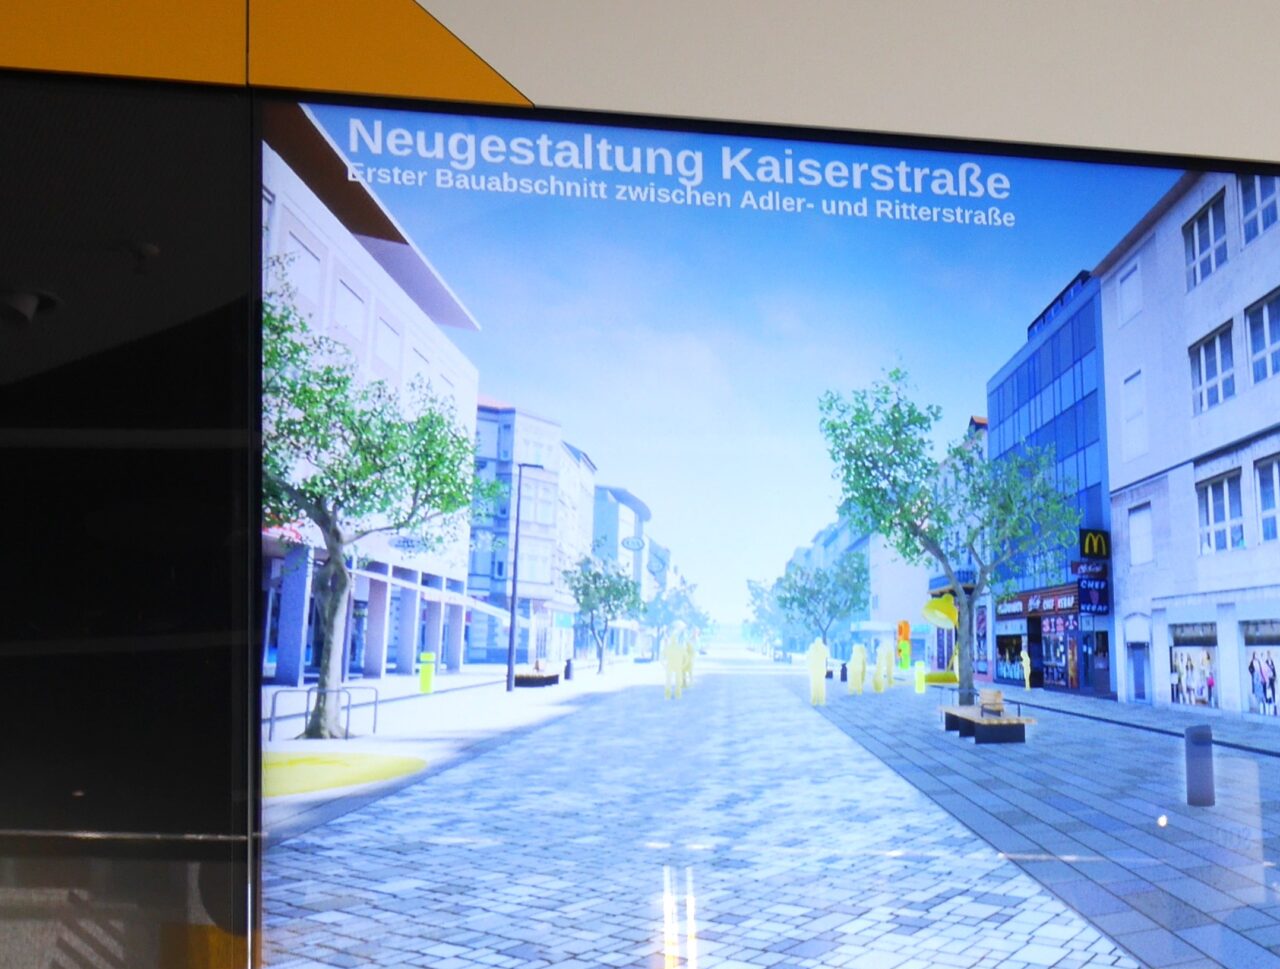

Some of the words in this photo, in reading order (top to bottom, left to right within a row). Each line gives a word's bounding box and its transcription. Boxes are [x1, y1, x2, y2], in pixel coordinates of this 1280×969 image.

[348, 118, 704, 188] Neugestaltung
[721, 145, 1012, 199] Kaiserstraße
[348, 162, 427, 187] Erster
[434, 168, 608, 199] Bauabschnitt
[615, 181, 732, 209] zwischen
[739, 190, 815, 213] Adler-
[821, 197, 868, 217] und
[876, 199, 1017, 228] Ritterstraße
